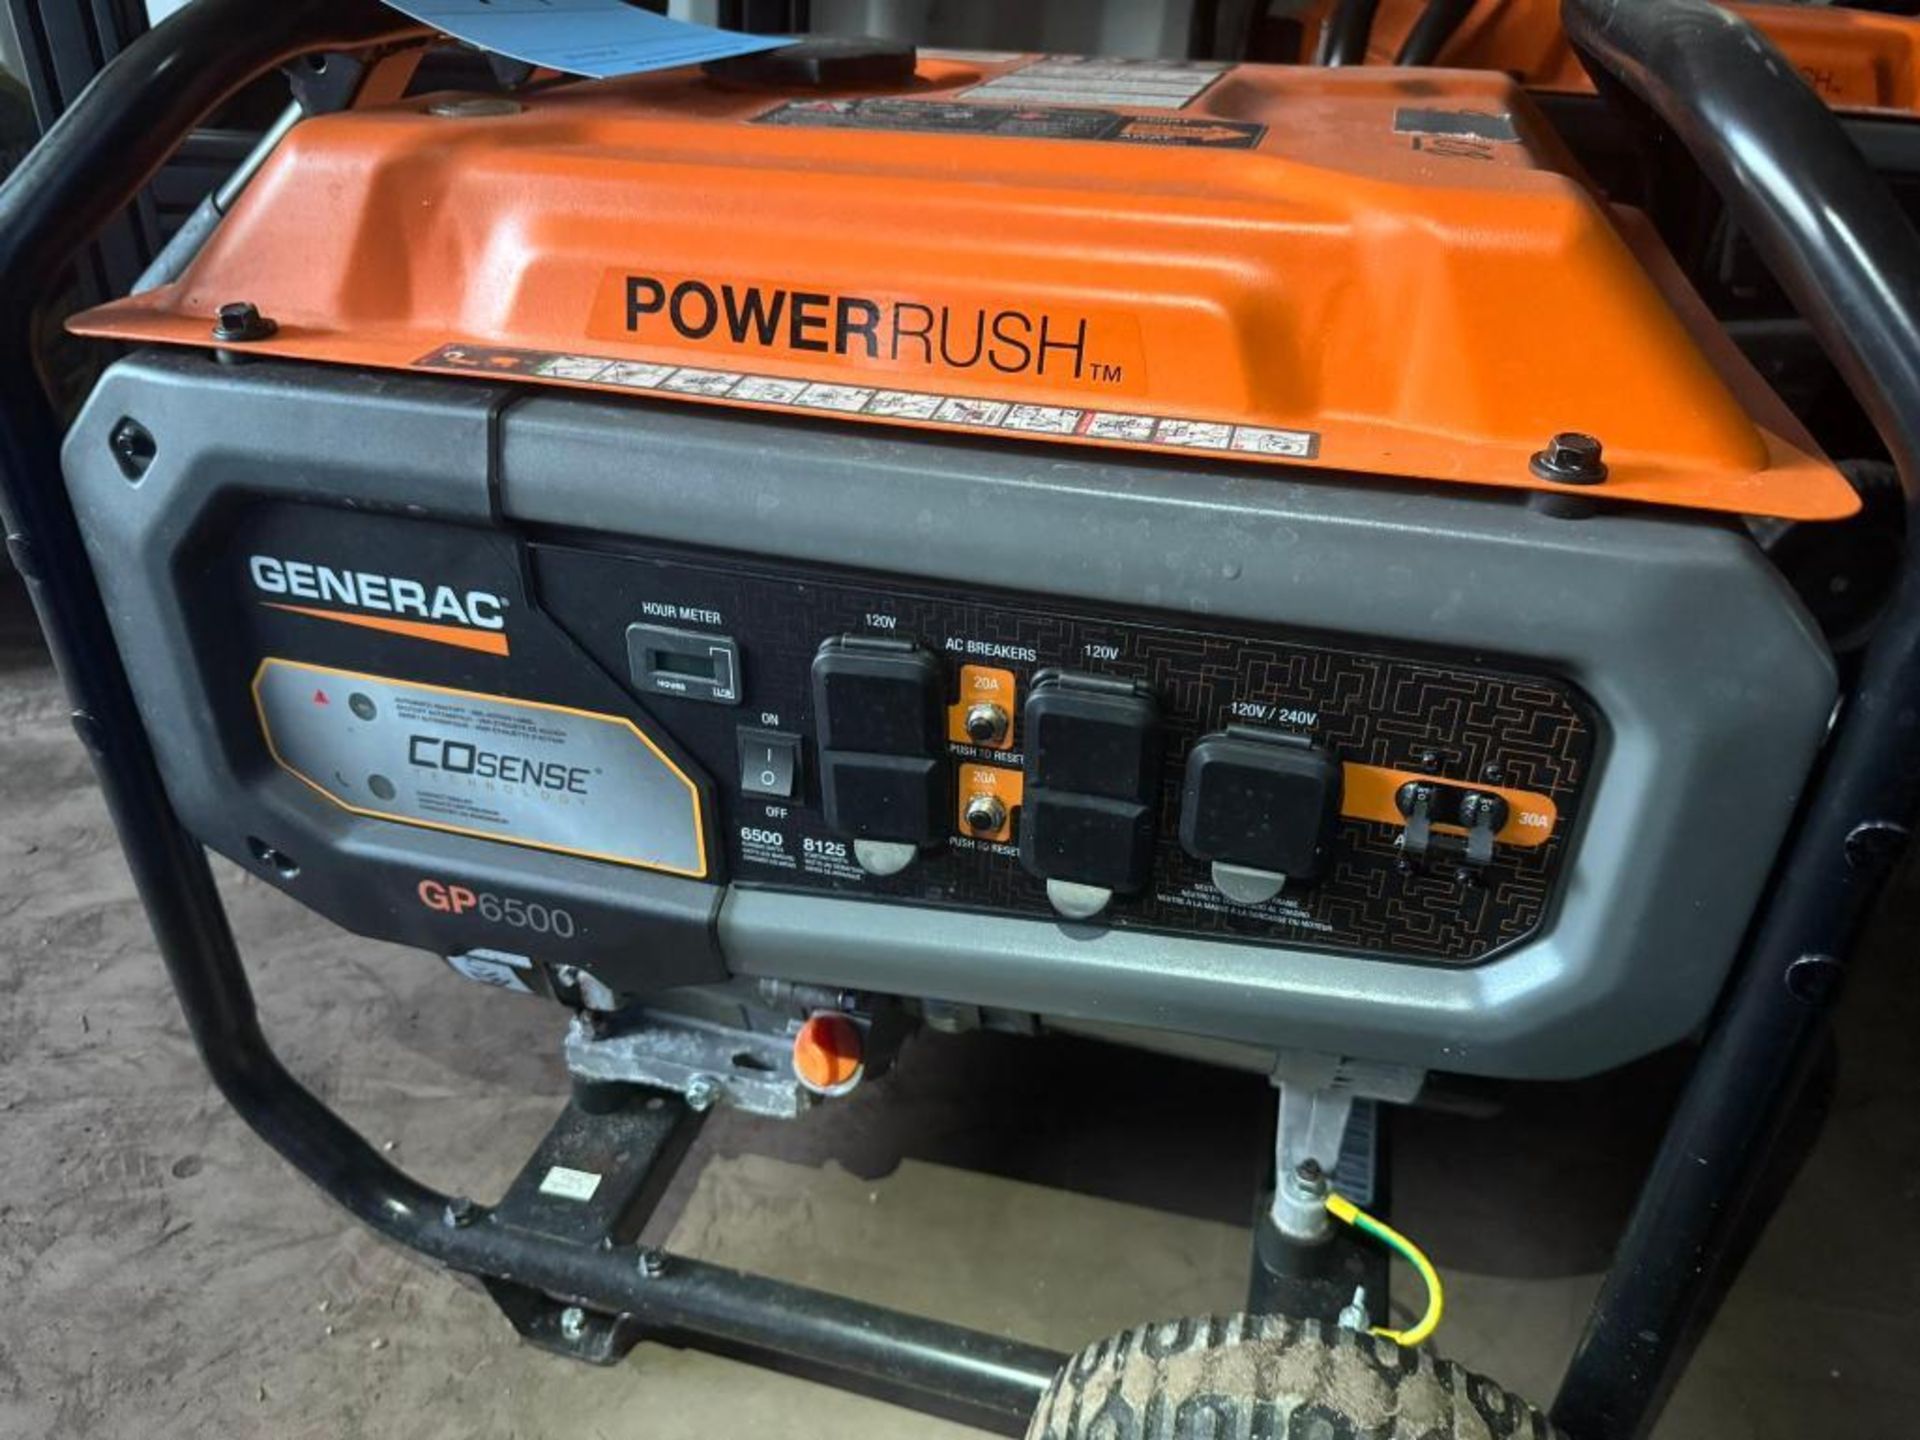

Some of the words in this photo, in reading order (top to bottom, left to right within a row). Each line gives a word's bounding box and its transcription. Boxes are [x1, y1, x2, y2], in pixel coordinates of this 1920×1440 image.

[249, 555, 505, 630] GENERAC
[641, 601, 677, 619] HOUR
[679, 606, 722, 625] METER
[865, 613, 897, 630] 120V
[945, 637, 964, 651] AC
[966, 640, 1038, 663] BREAKERS
[1083, 643, 1120, 661] 120V
[973, 675, 1000, 691] 20A
[761, 712, 780, 727] ON
[1230, 701, 1267, 719] 120V
[1279, 708, 1319, 726] 240V
[950, 743, 977, 758] PUSH
[765, 805, 789, 820] OFF
[1518, 811, 1549, 828] 30A
[741, 826, 784, 847] 6500
[948, 836, 976, 850] PUSH
[803, 837, 847, 858] 8125
[417, 879, 575, 939] GP6500
